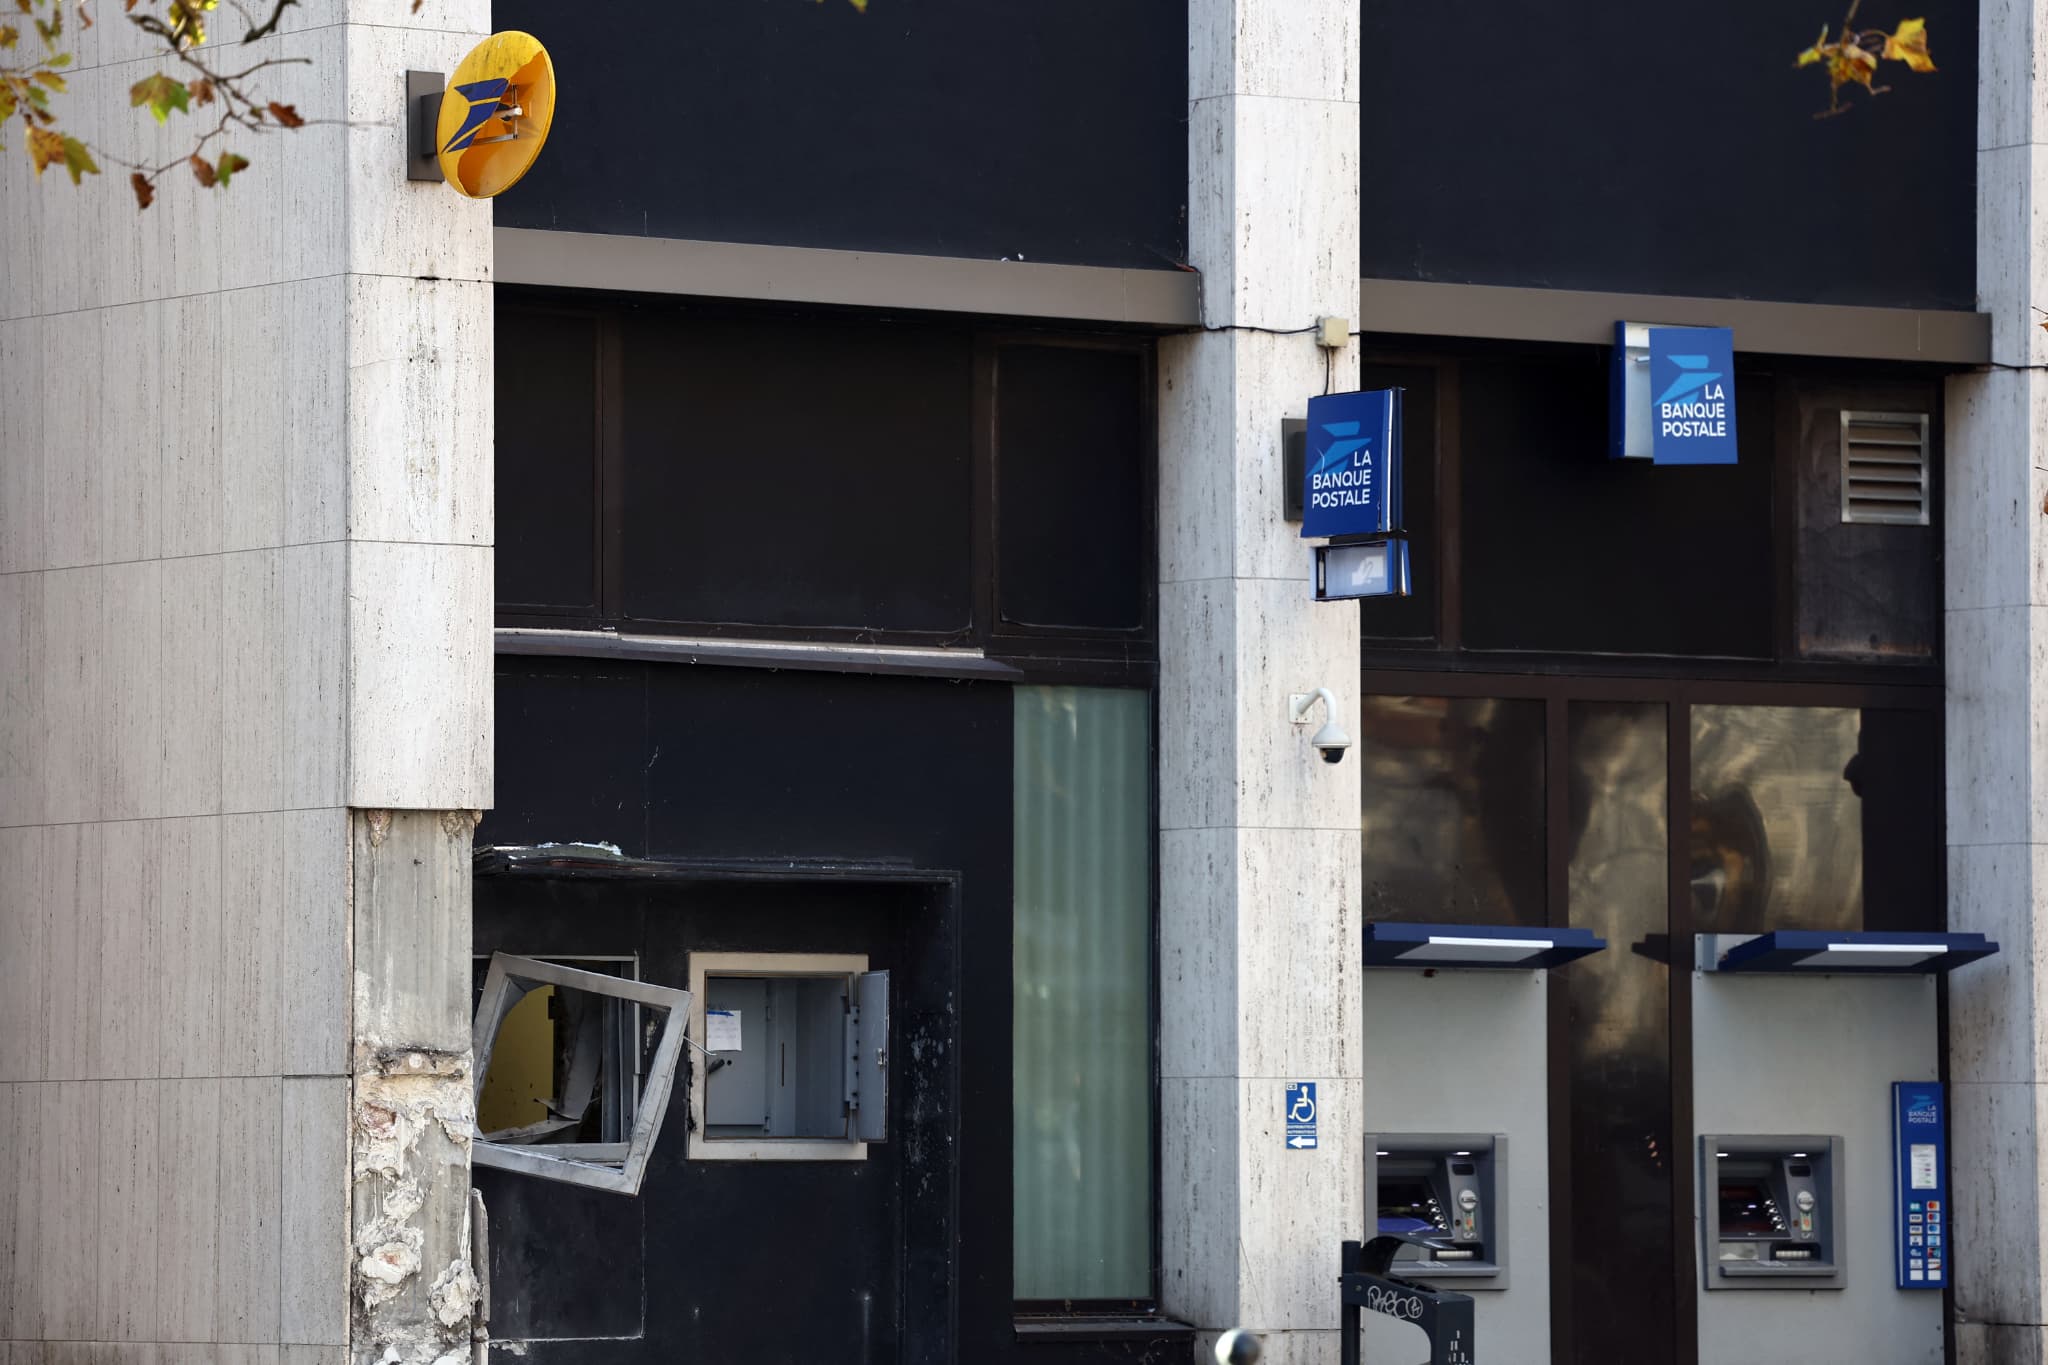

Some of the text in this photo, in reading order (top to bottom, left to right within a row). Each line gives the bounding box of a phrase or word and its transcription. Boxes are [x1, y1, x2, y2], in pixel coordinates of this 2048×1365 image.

[1705, 384, 1725, 400] LA
[1661, 402, 1725, 419] BANQUE
[1662, 421, 1727, 437] POSTALE
[1354, 450, 1372, 467] LA
[1312, 469, 1371, 490] BANQUE
[1312, 488, 1370, 509] POSTALE
